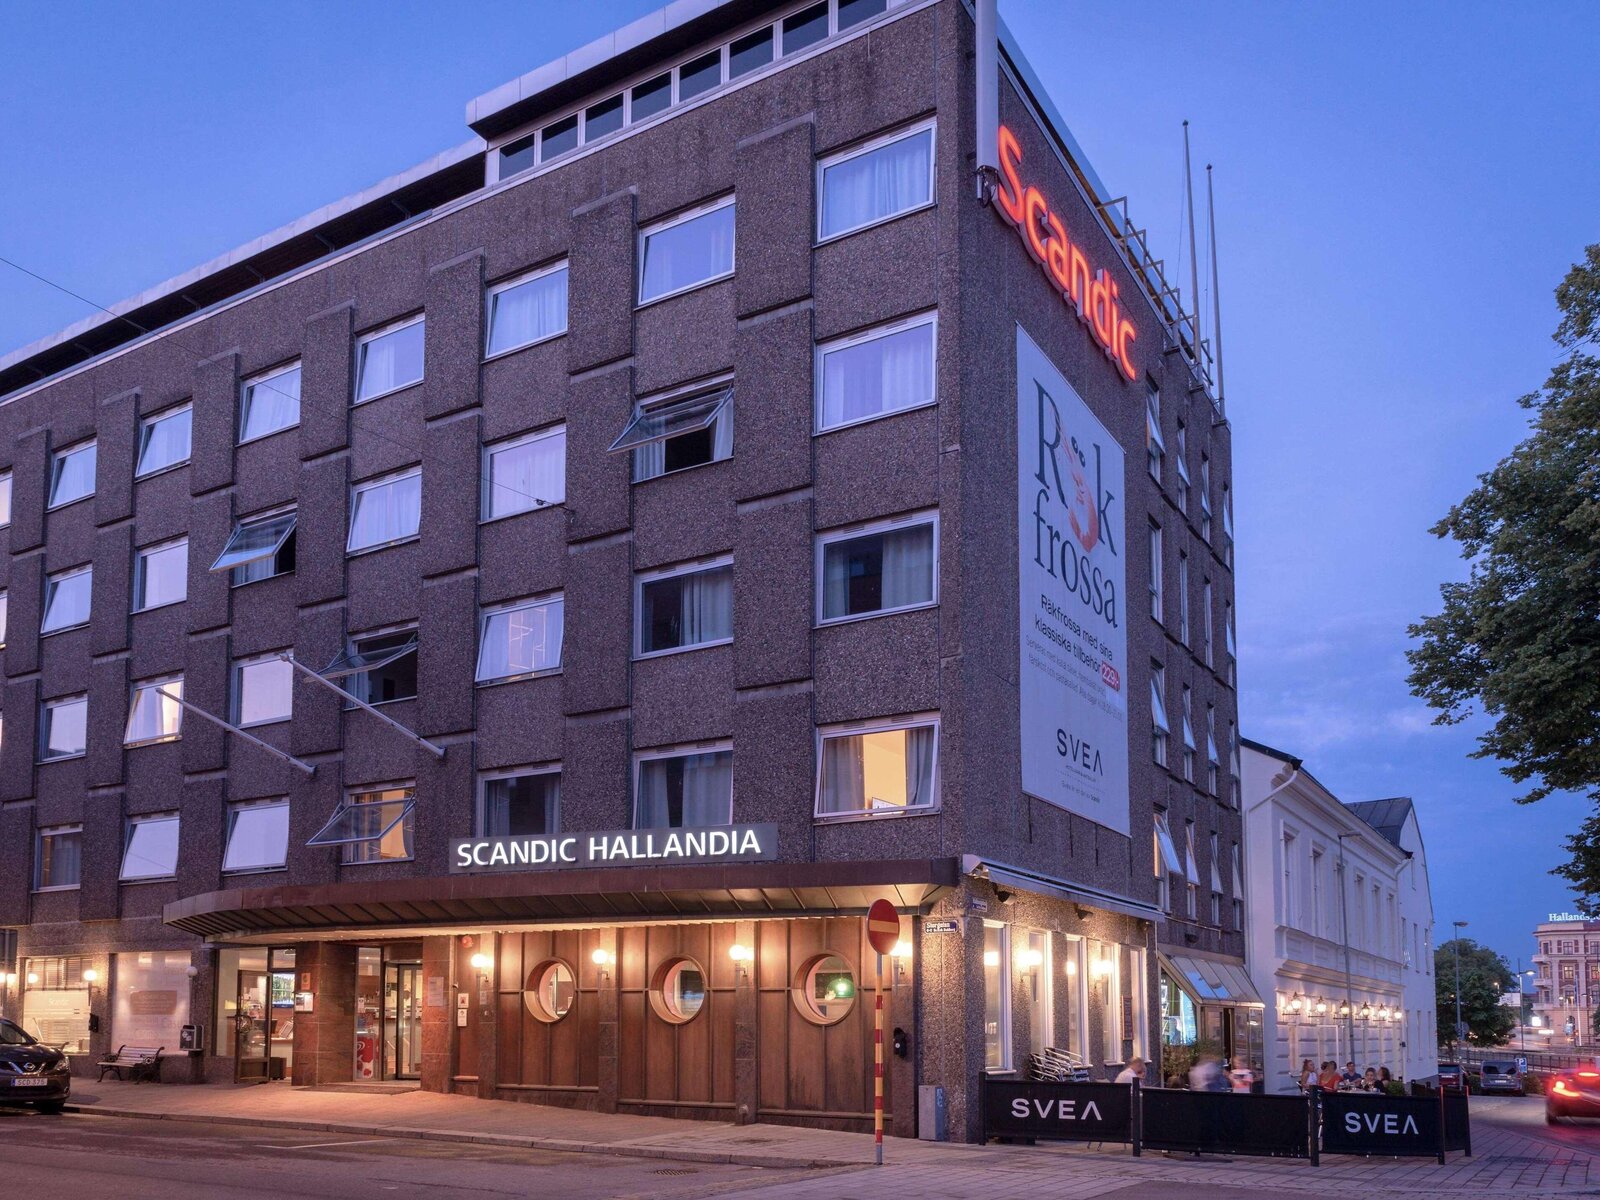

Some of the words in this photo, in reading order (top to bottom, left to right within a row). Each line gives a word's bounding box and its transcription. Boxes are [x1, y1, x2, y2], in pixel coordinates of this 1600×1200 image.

[994, 124, 1137, 382] Scandic
[1033, 488, 1118, 629] frossa
[1035, 613, 1072, 653] klassiska
[1082, 629, 1098, 650] med
[1100, 641, 1113, 661] sina
[1056, 728, 1103, 777] SVEA
[456, 837, 577, 868] SCANDIC
[588, 829, 762, 861] HALLANDIA
[1011, 1097, 1103, 1121] SVEA
[1344, 1111, 1420, 1135] SVEA
